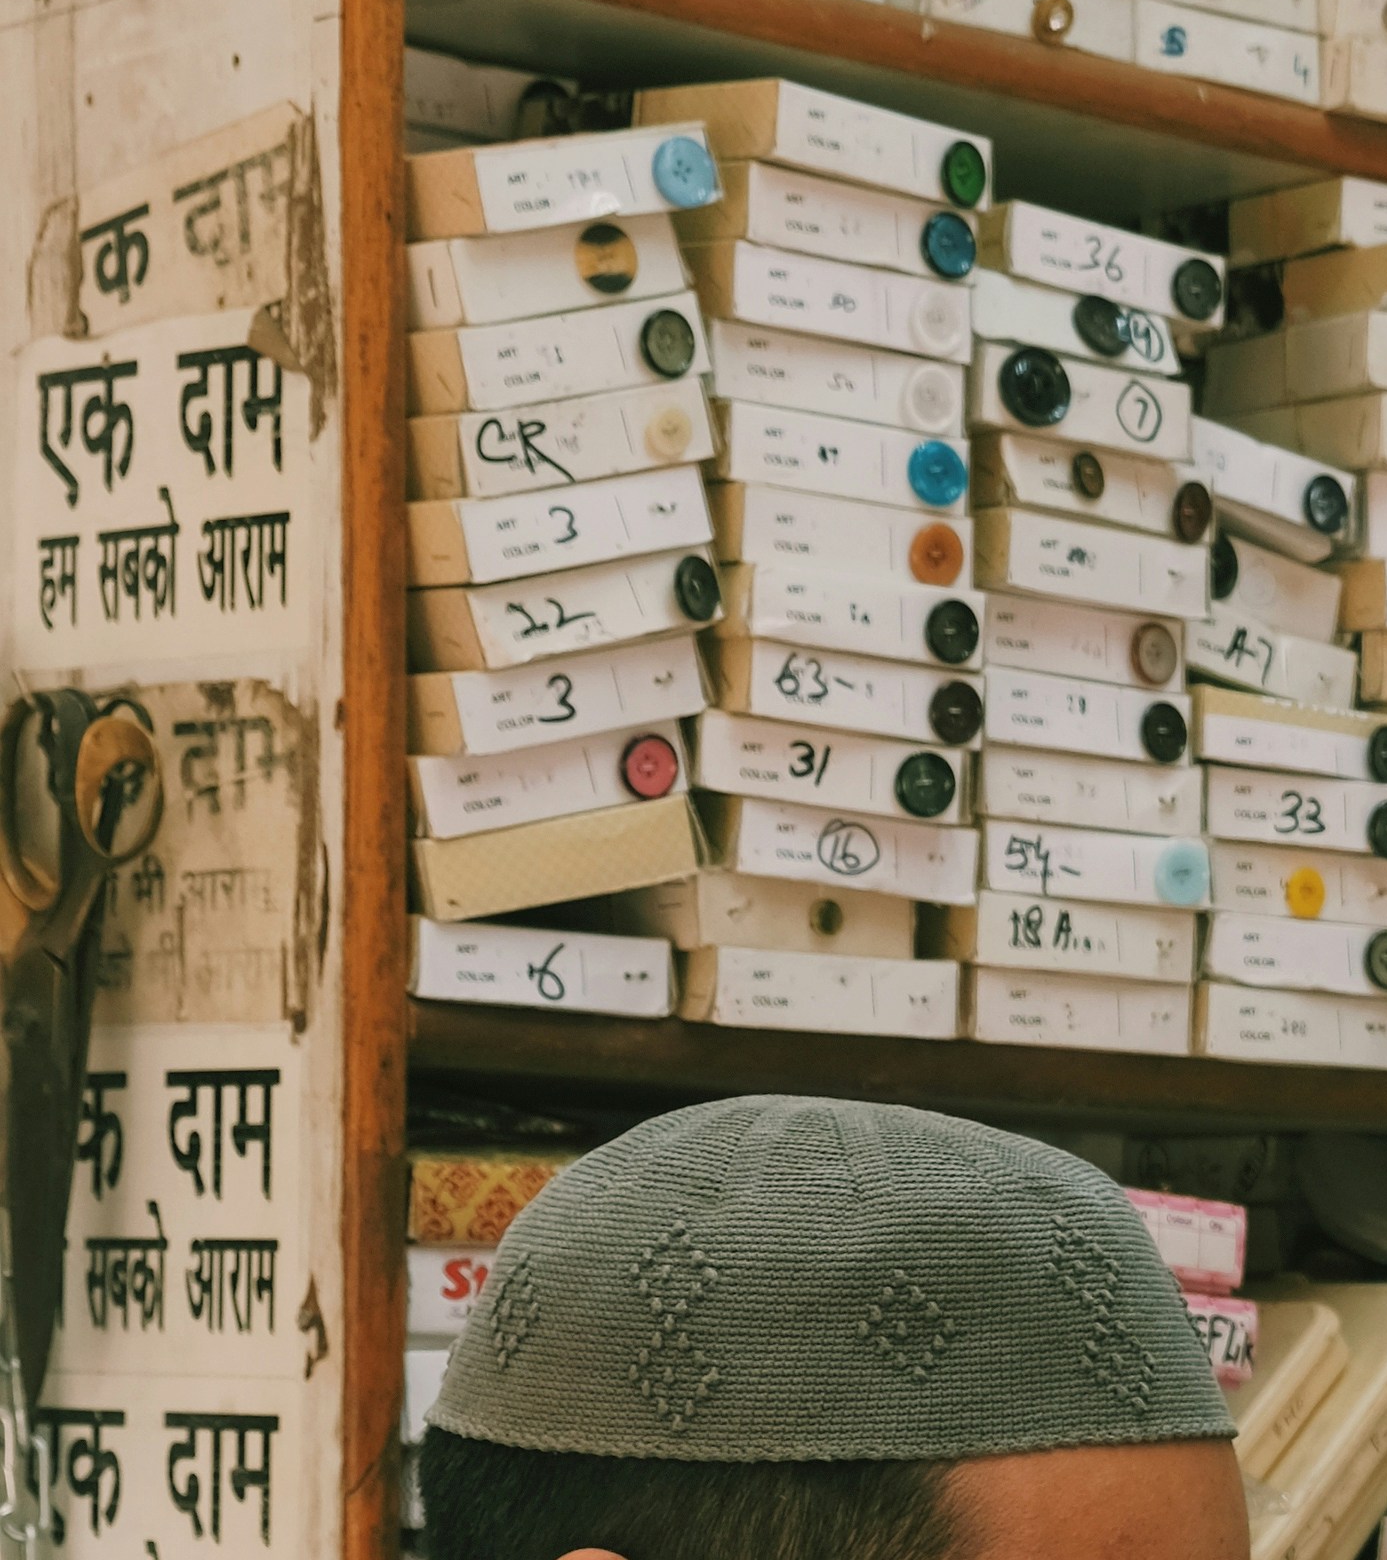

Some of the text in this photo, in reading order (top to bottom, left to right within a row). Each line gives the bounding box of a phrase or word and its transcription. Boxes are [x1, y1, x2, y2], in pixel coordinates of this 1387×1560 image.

[37, 344, 285, 509] एक दाम
[475, 417, 576, 484] CR
[38, 486, 290, 632] हम सबको आराम
[548, 506, 579, 545] 3
[538, 672, 578, 723] 3
[1275, 790, 1326, 834] 33
[165, 1068, 282, 1201] दाम
[84, 1201, 279, 1335] सबको आराम
[165, 1413, 280, 1546] दाम
